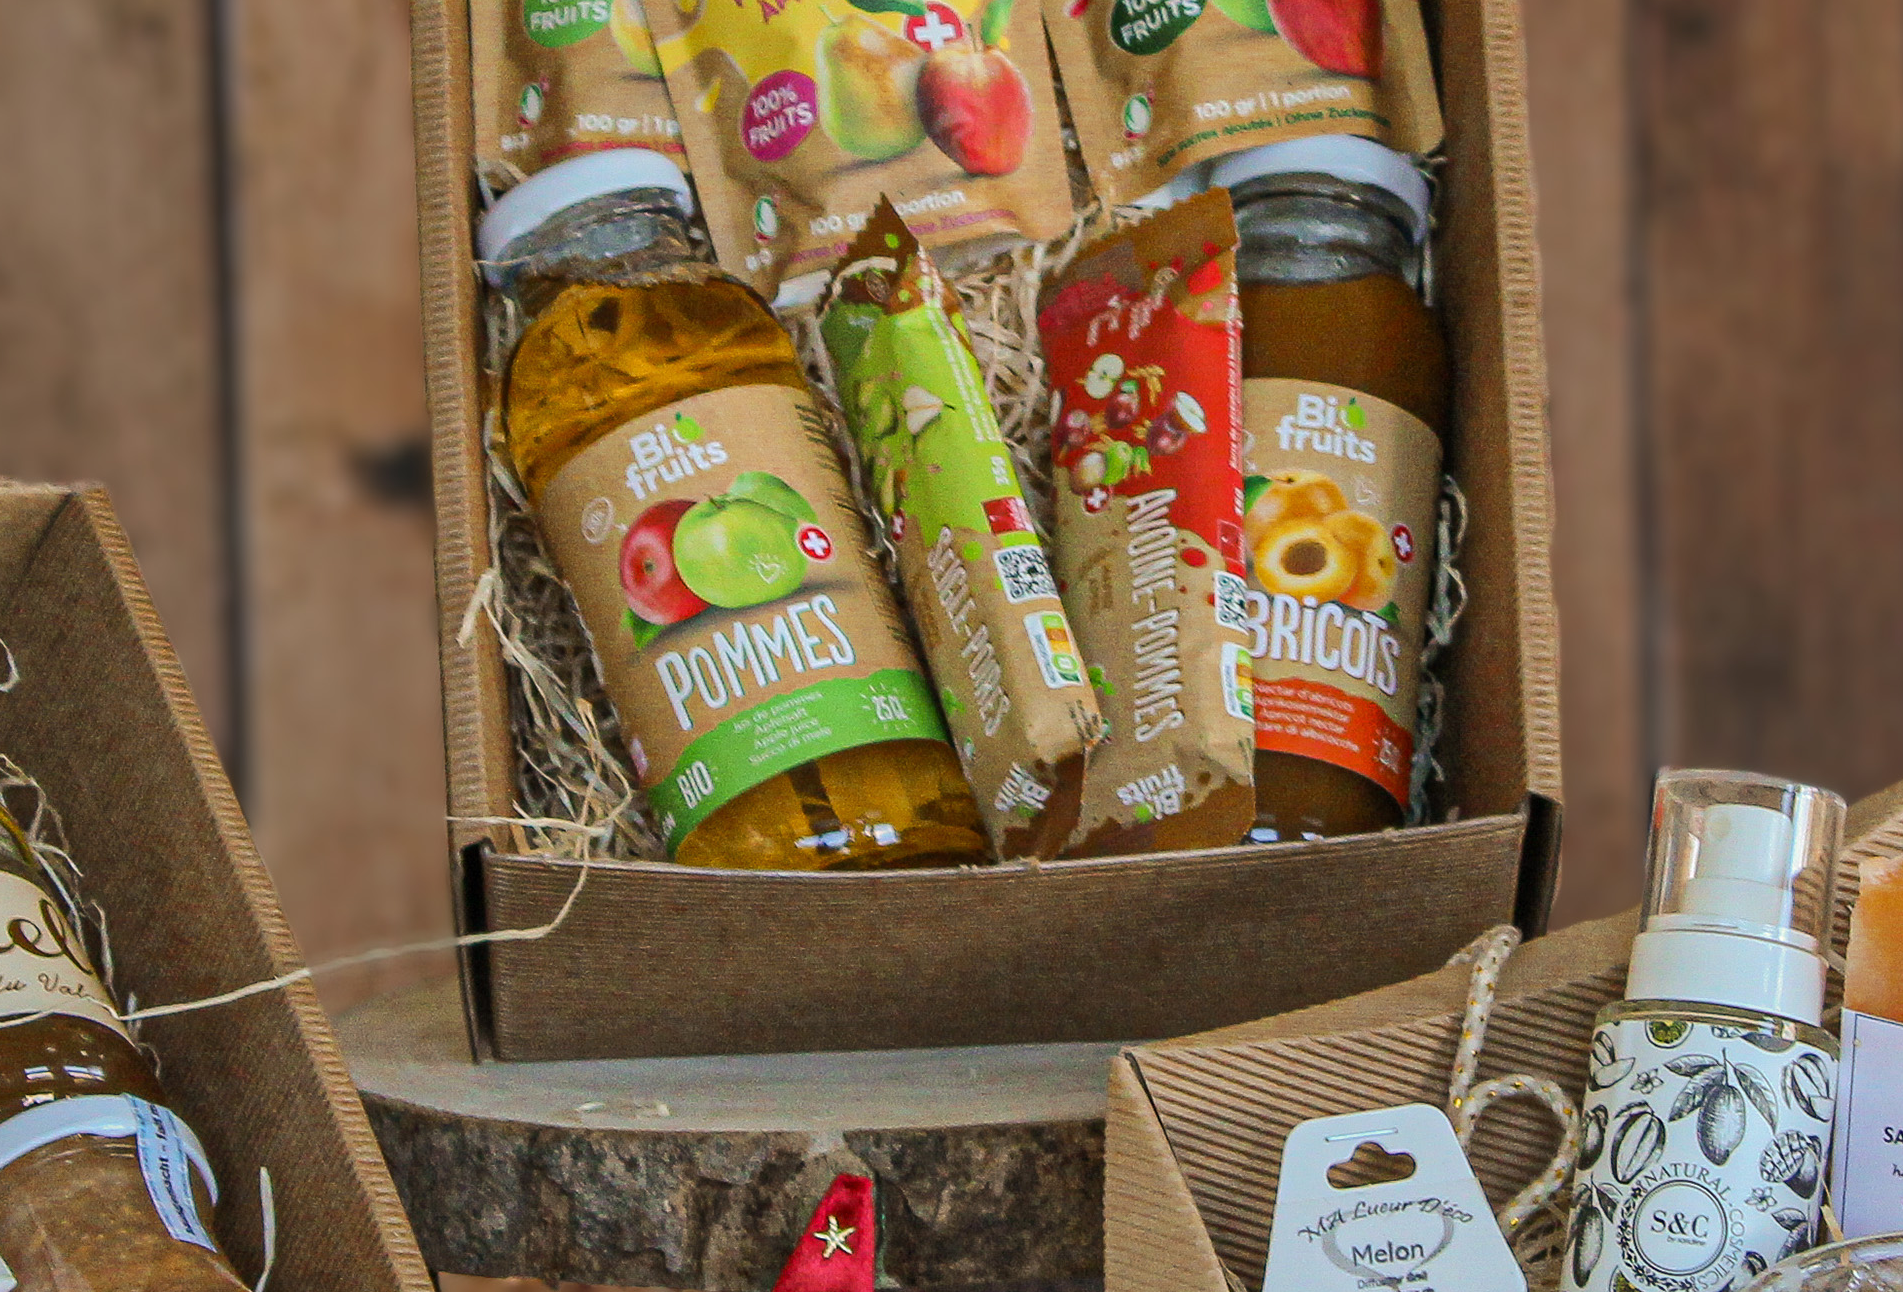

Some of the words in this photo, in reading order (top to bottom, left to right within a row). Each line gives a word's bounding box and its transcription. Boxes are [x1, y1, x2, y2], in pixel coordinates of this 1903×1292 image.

[751, 85, 799, 118] 100%
[748, 105, 816, 150] FRUITS
[1274, 413, 1377, 465] fruits
[624, 439, 729, 501] fruits
[654, 593, 857, 732] POMMES
[1351, 1200, 1416, 1222] Lueur
[1643, 1161, 1732, 1202] NATURAL
[1697, 1208, 1746, 1290] COSMETICS
[1650, 1208, 1710, 1239] S&C
[1351, 1240, 1425, 1268] Melon
